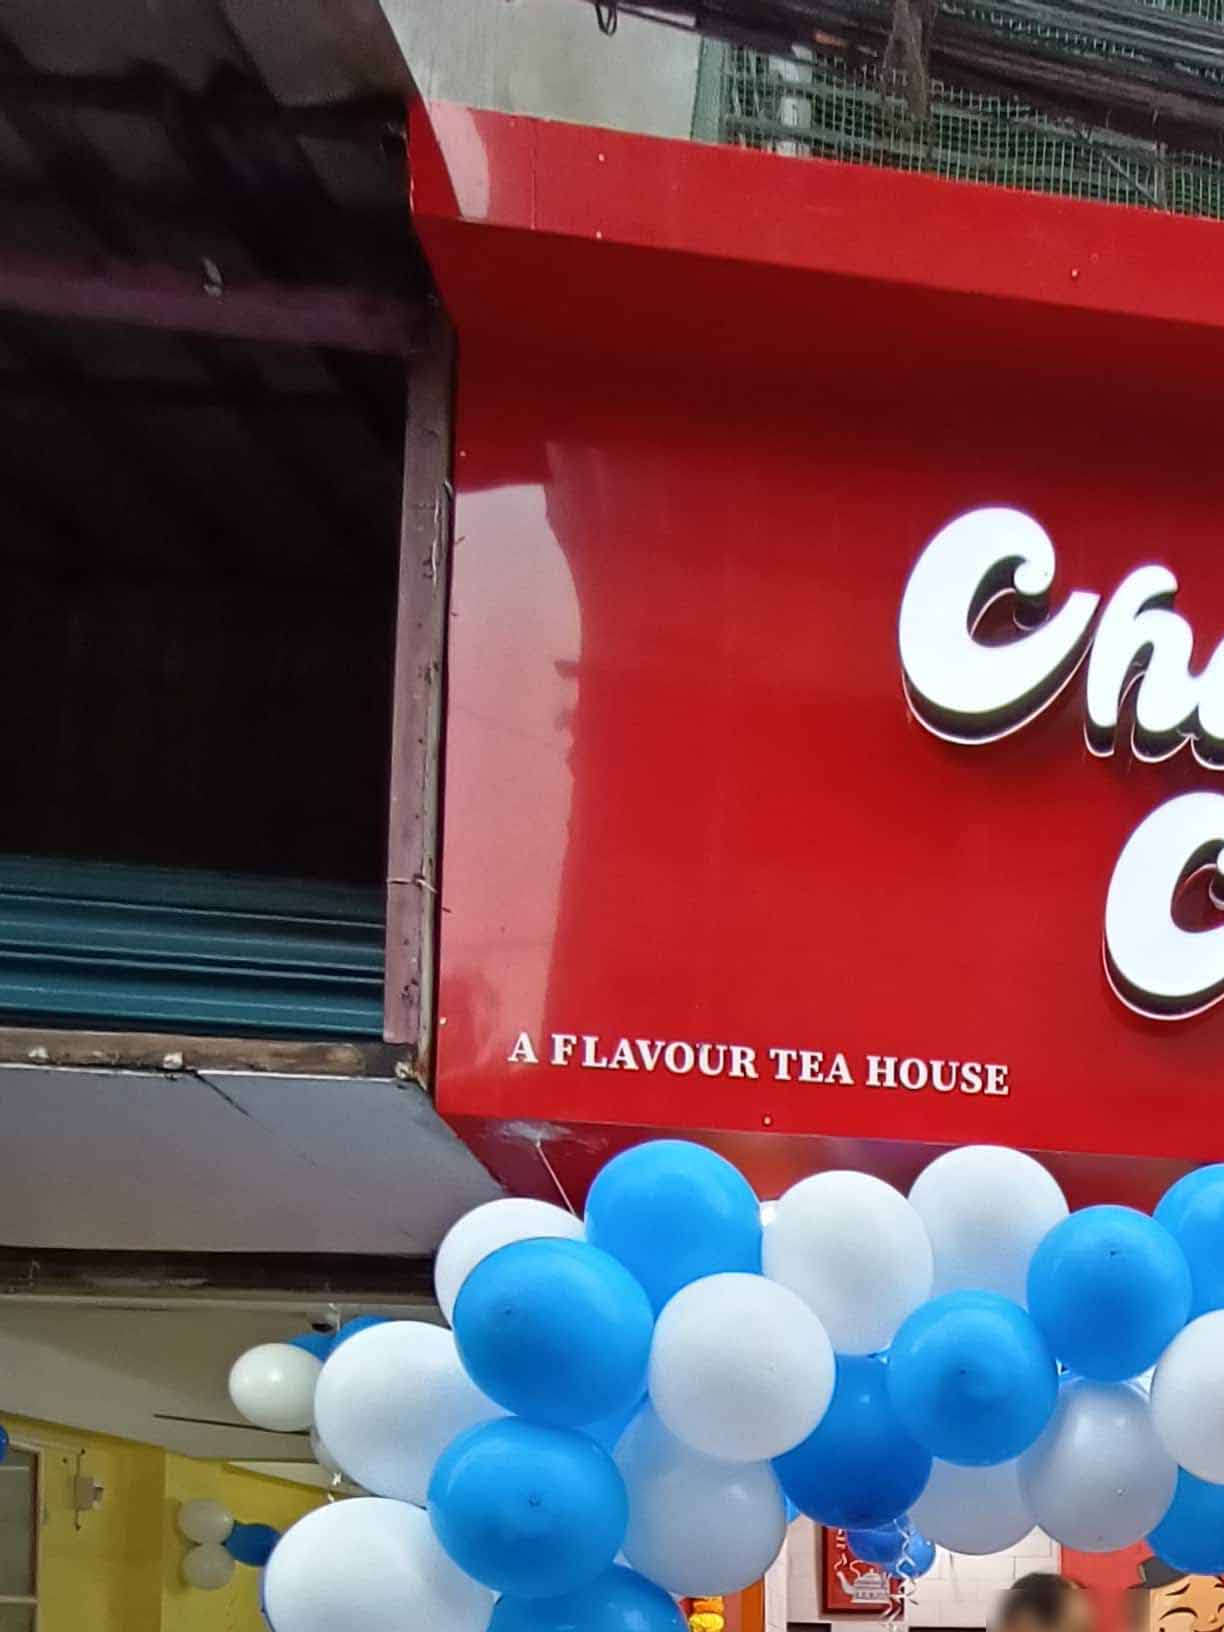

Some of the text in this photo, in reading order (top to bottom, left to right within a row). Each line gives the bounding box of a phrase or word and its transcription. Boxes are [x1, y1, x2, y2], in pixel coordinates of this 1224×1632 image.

[507, 1031, 1009, 1096] A FLAVOUR TEA HOUSE
